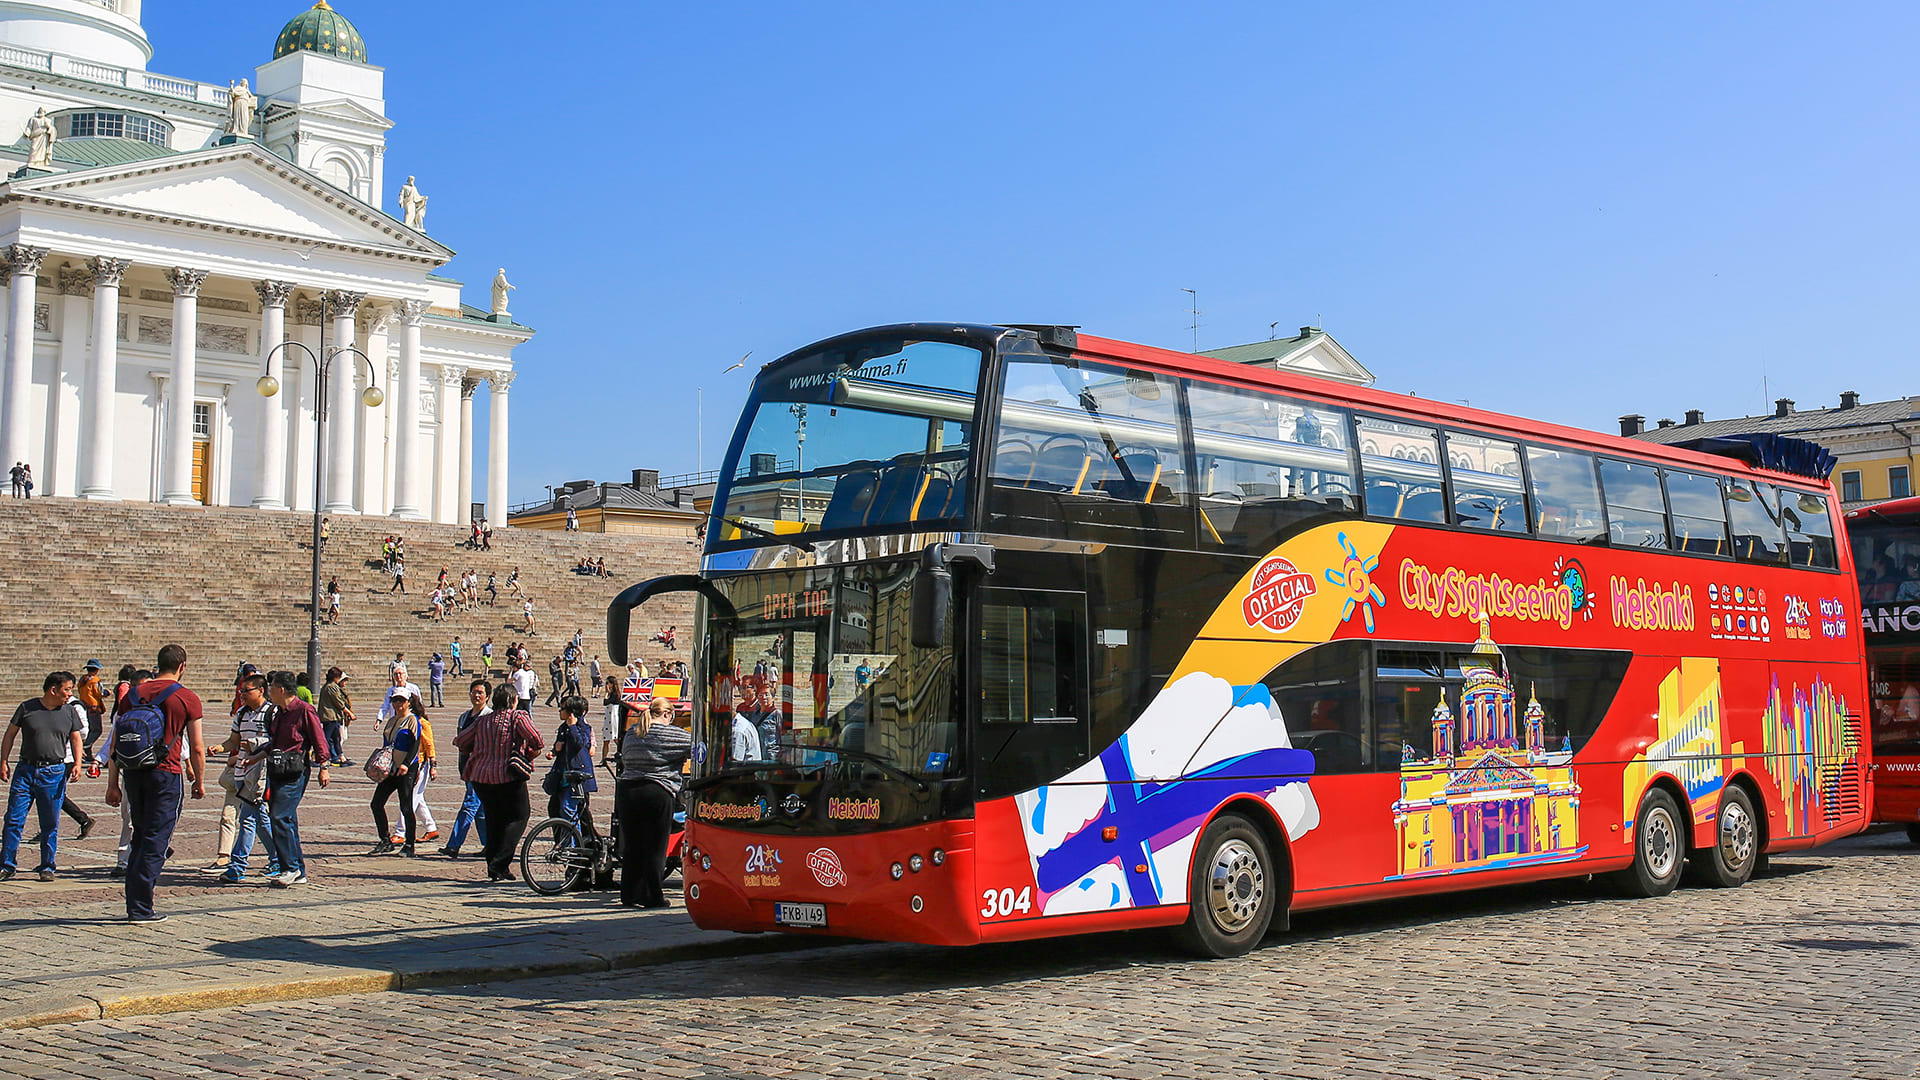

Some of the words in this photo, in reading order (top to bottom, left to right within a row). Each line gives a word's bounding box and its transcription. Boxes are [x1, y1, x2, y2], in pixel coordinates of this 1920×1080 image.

[1255, 571, 1265, 587] CITY
[763, 592, 796, 620] OPEN
[804, 589, 828, 617] TOP
[1250, 576, 1313, 619] OFFICIAL
[1610, 575, 1695, 632] Helsinki
[1784, 594, 1800, 625] 24
[1819, 598, 1834, 618] Hop
[1833, 597, 1844, 616] On
[1273, 604, 1300, 627] TOUR
[1822, 618, 1836, 639] Hop
[1836, 618, 1847, 637] Off
[828, 797, 881, 820] Helsinki
[745, 844, 765, 873] 24
[810, 856, 844, 883] OFFICIAL
[818, 873, 834, 885] TOUR
[782, 906, 823, 922] FKB-149
[981, 885, 1032, 918] 304
